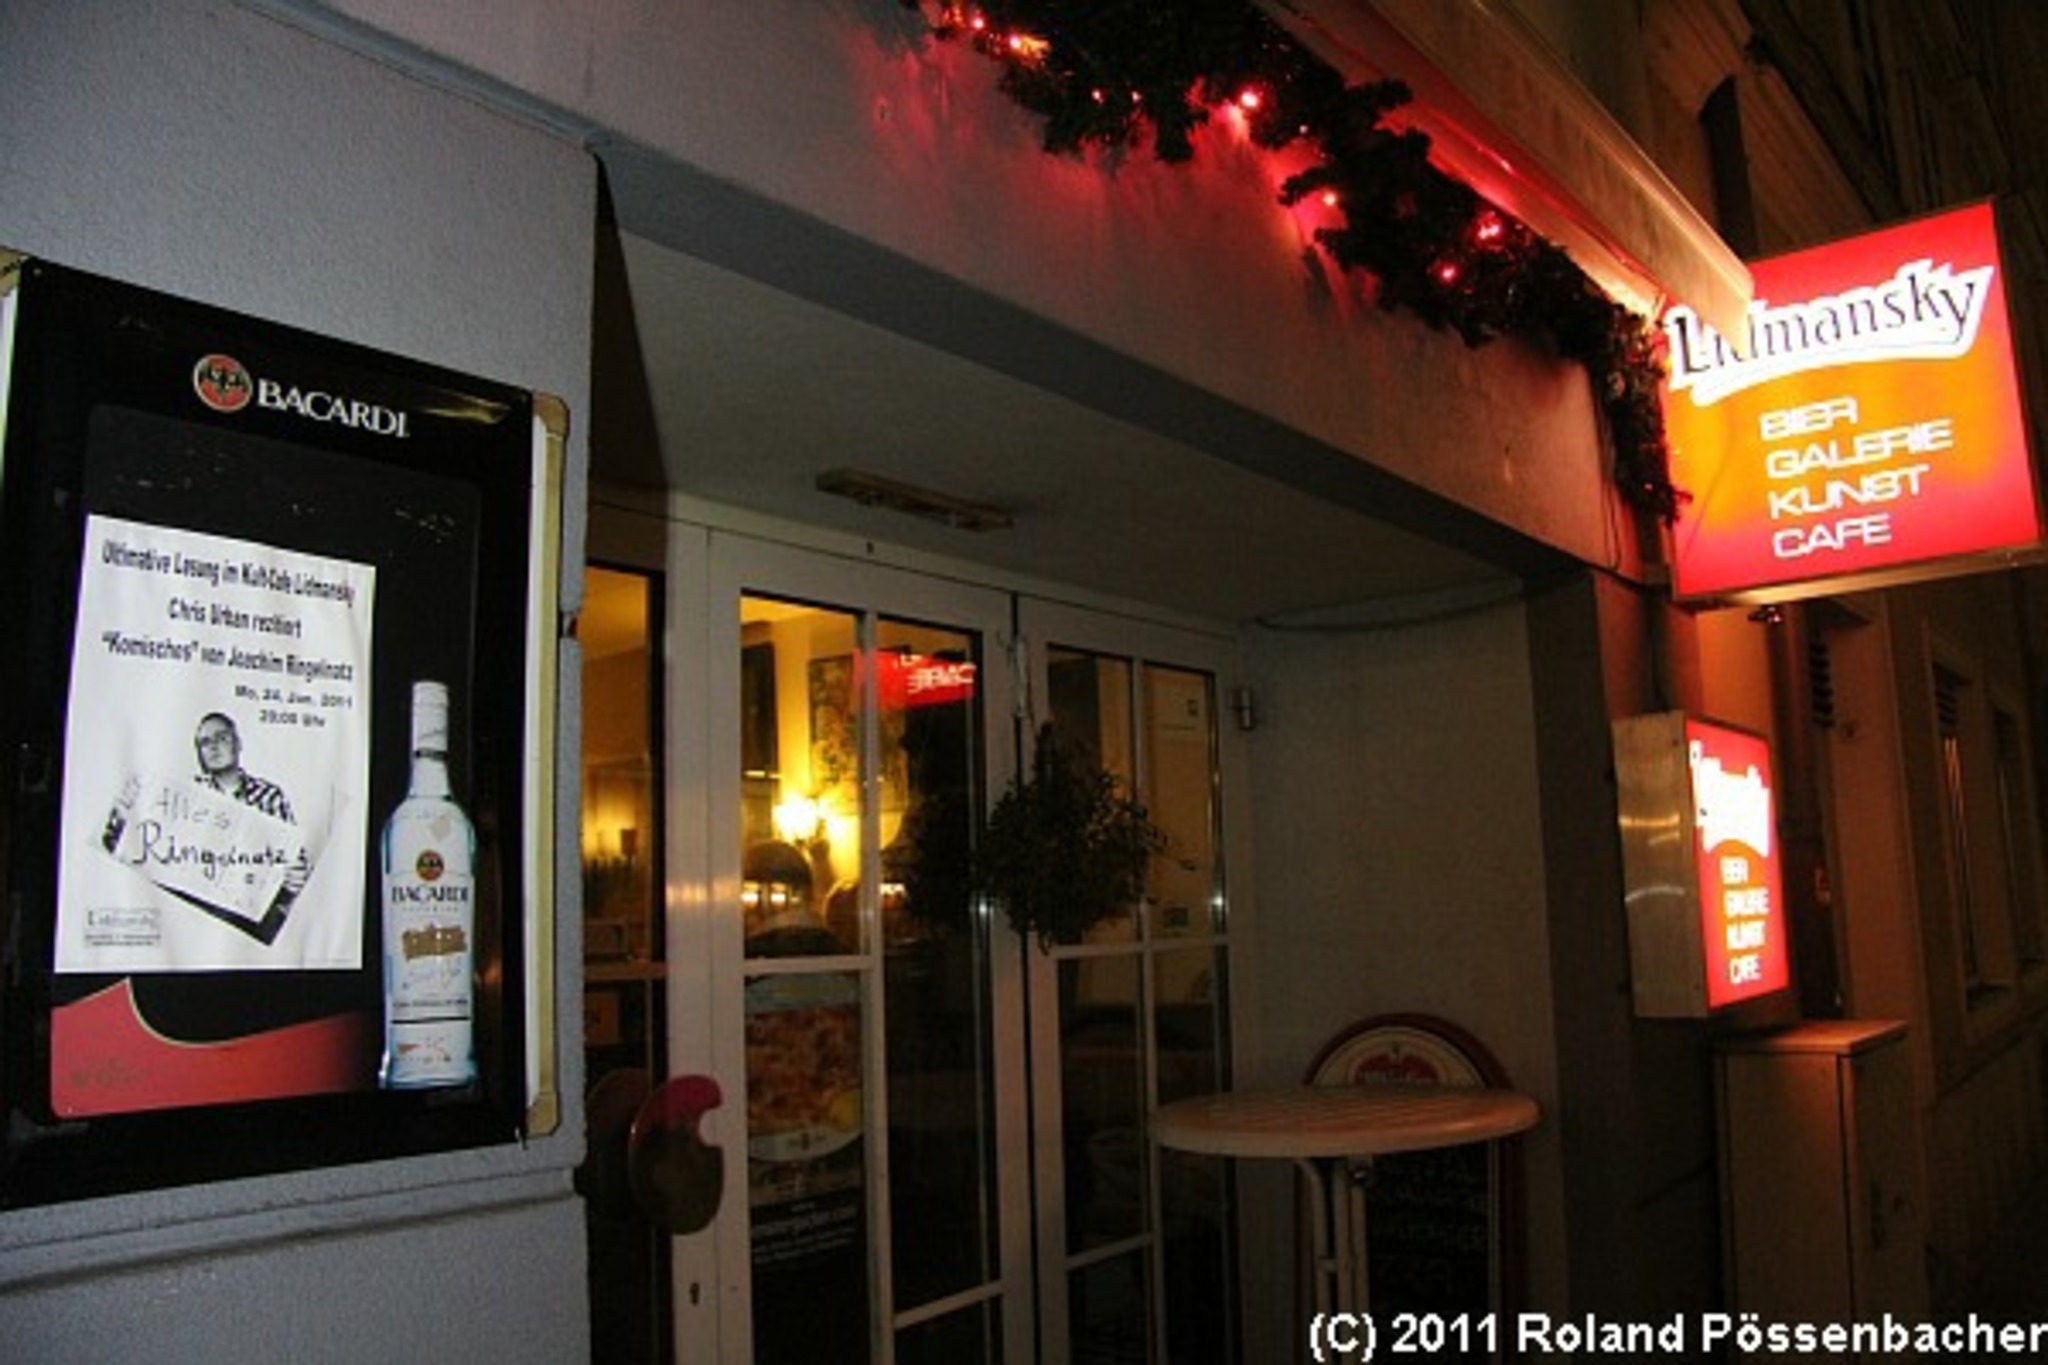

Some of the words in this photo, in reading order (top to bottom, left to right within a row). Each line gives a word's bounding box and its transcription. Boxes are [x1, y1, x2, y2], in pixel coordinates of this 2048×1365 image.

[256, 378, 410, 438] BACARDI
[1760, 396, 1858, 441] BIER
[1766, 420, 1954, 478] GALERIE
[1770, 465, 1931, 519] KUNST
[1773, 514, 1892, 557] CAFE
[101, 539, 171, 574] Ultimative
[173, 552, 220, 587] Lesung
[222, 559, 239, 583] im
[167, 596, 206, 622] Chris
[210, 602, 250, 630] Urban
[200, 645, 227, 666] von
[227, 646, 284, 674] Joachim
[391, 883, 469, 904] BACARDI
